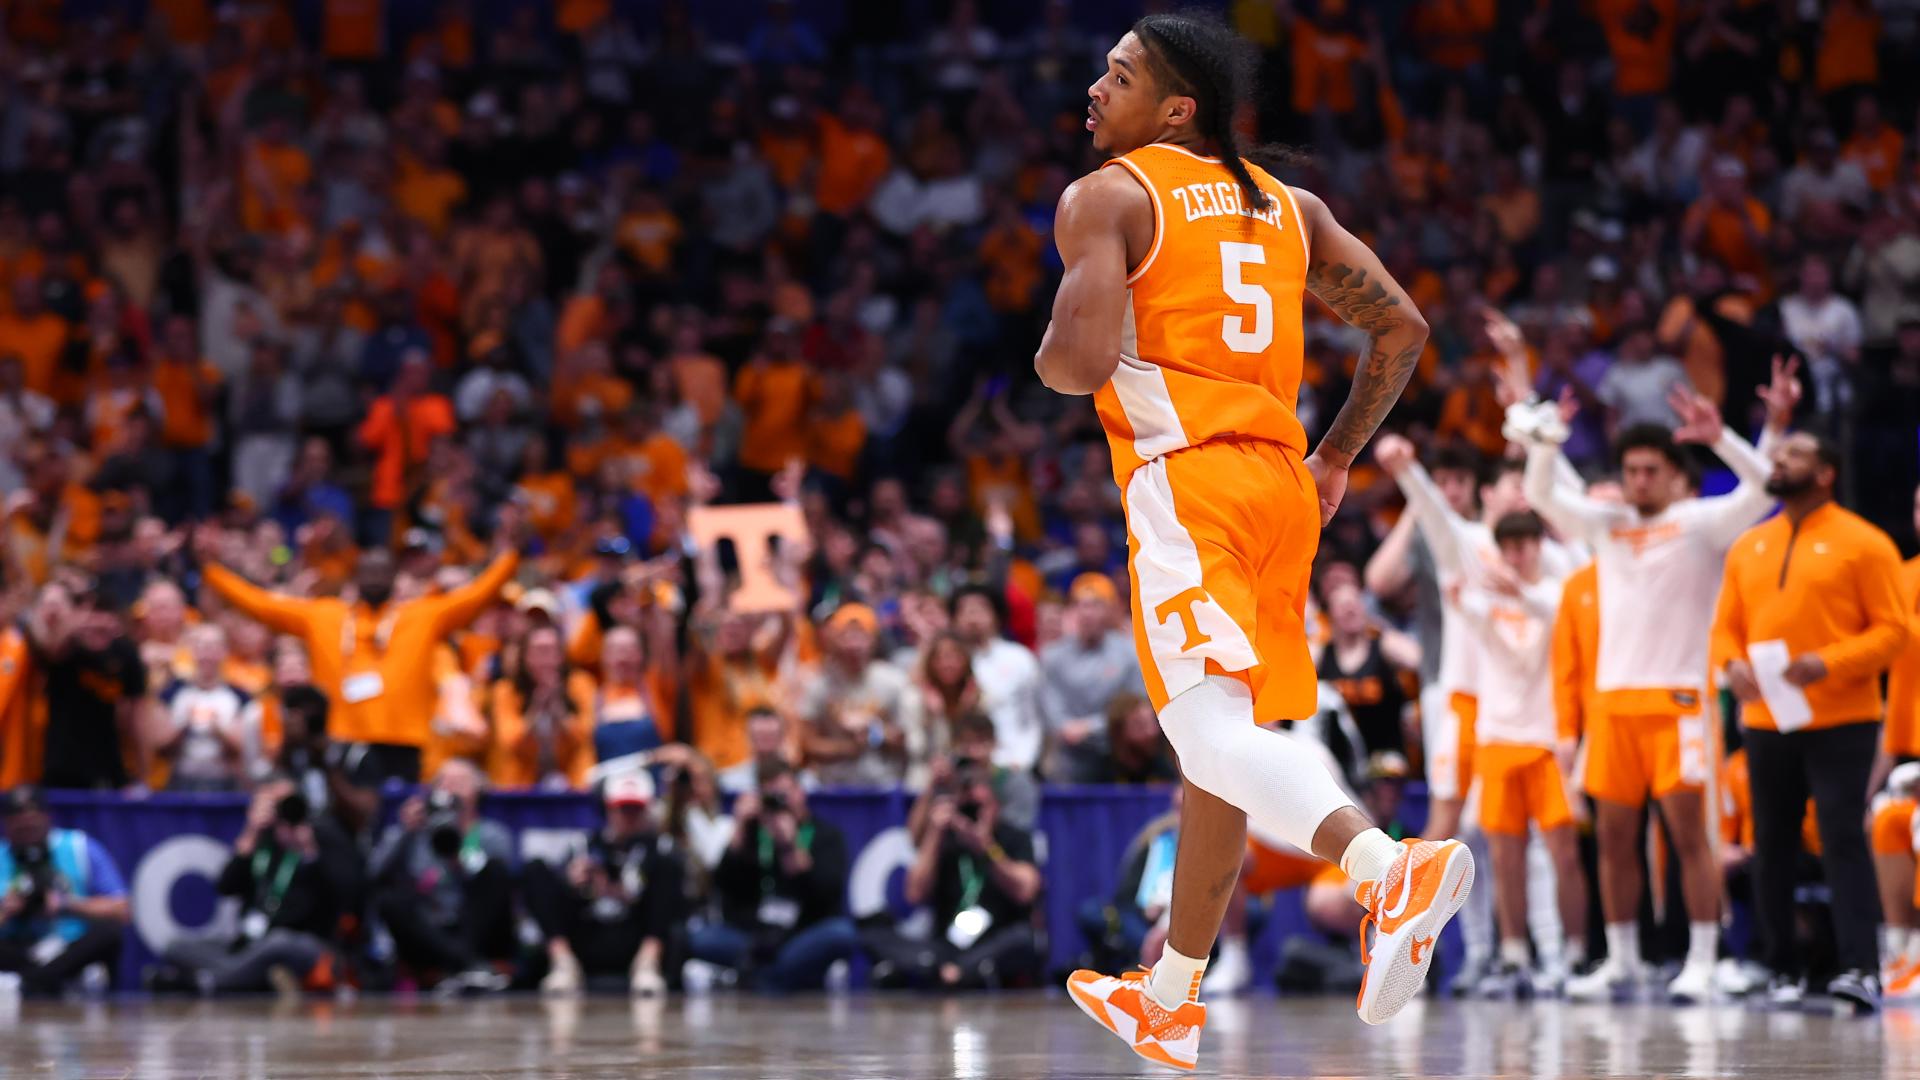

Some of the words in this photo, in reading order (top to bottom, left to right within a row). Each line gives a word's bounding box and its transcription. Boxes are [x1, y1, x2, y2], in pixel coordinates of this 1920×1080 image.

[1171, 181, 1283, 231] ZEIGLR
[1219, 240, 1273, 353] 5
[1154, 586, 1212, 653] T
